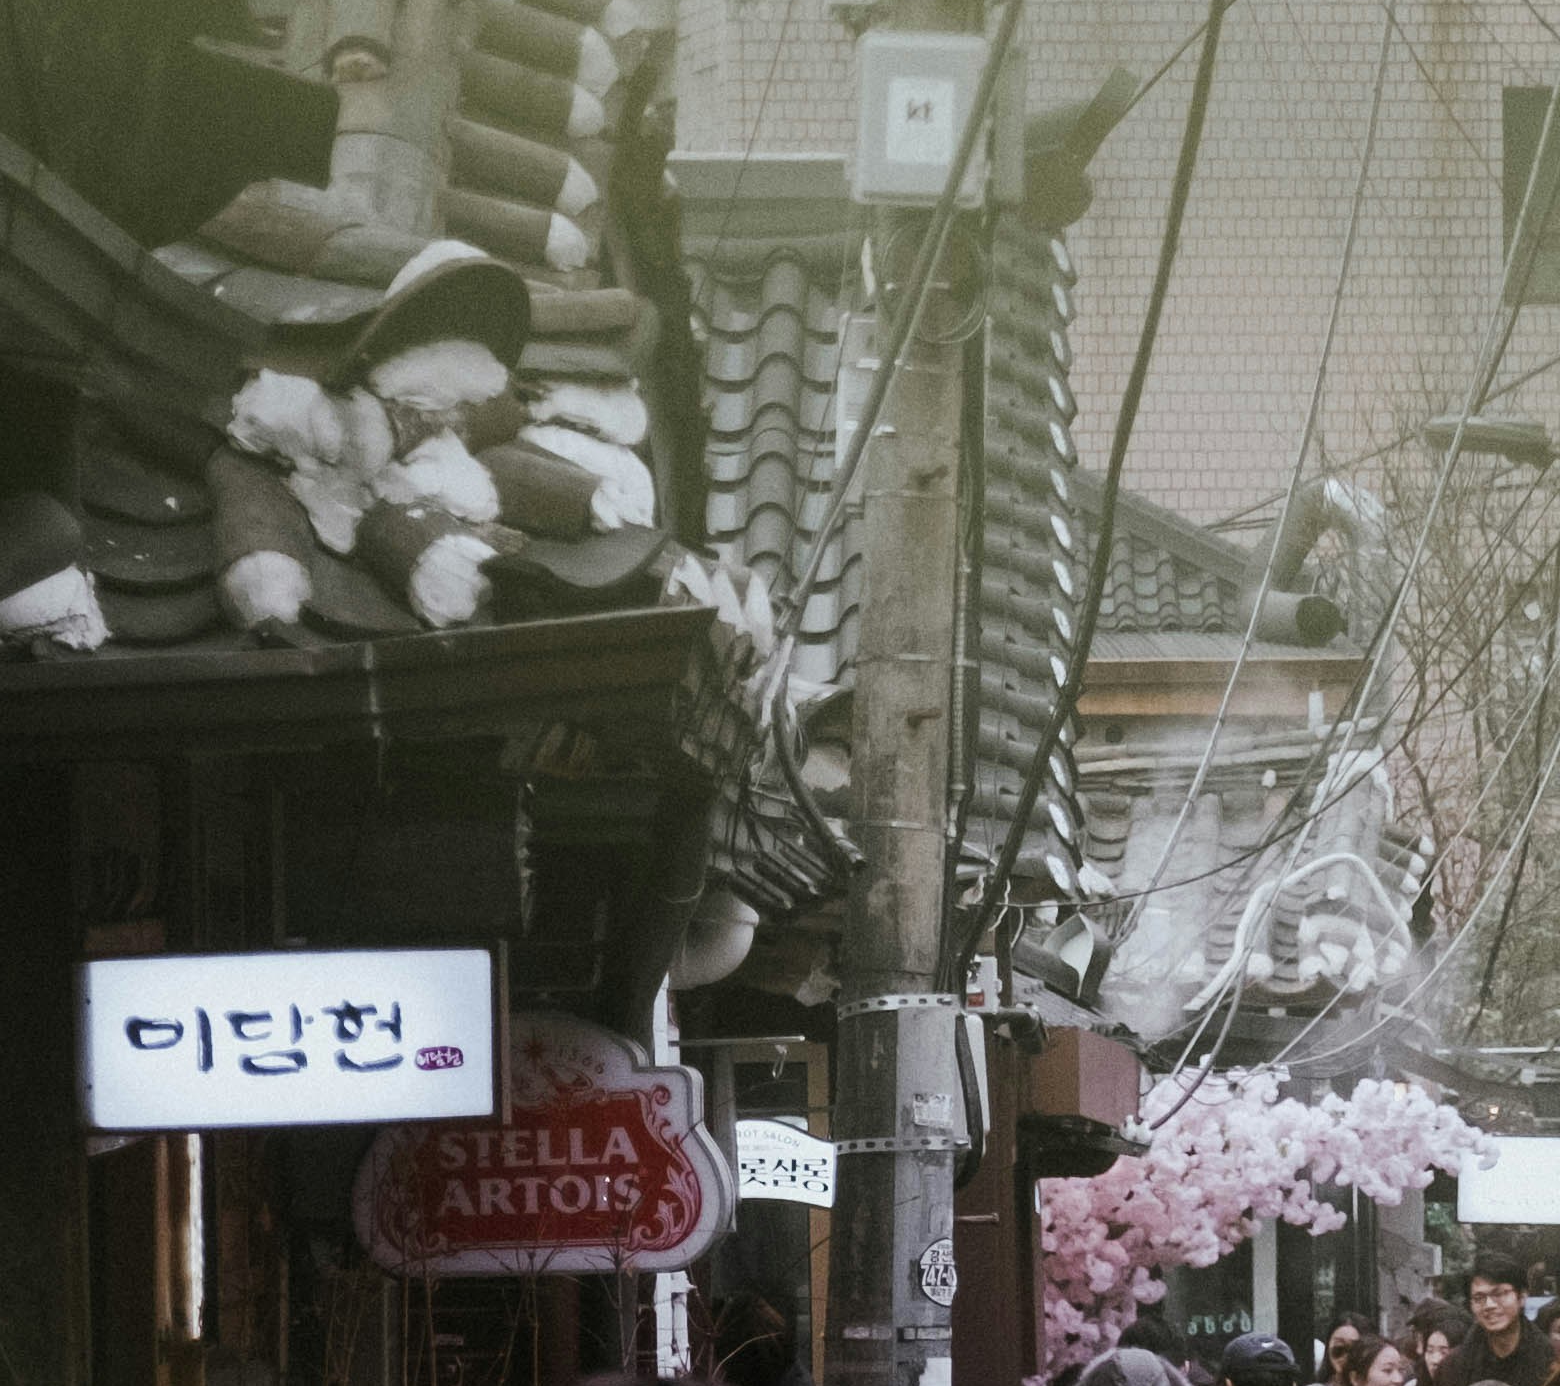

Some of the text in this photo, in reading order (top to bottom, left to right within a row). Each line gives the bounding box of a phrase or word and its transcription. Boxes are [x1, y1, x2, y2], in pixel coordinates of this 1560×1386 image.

[124, 1000, 405, 1076] 이담헌
[440, 1126, 639, 1168] STELLA
[438, 1173, 644, 1217] ARTOIS
[920, 1265, 958, 1286] 747-0
